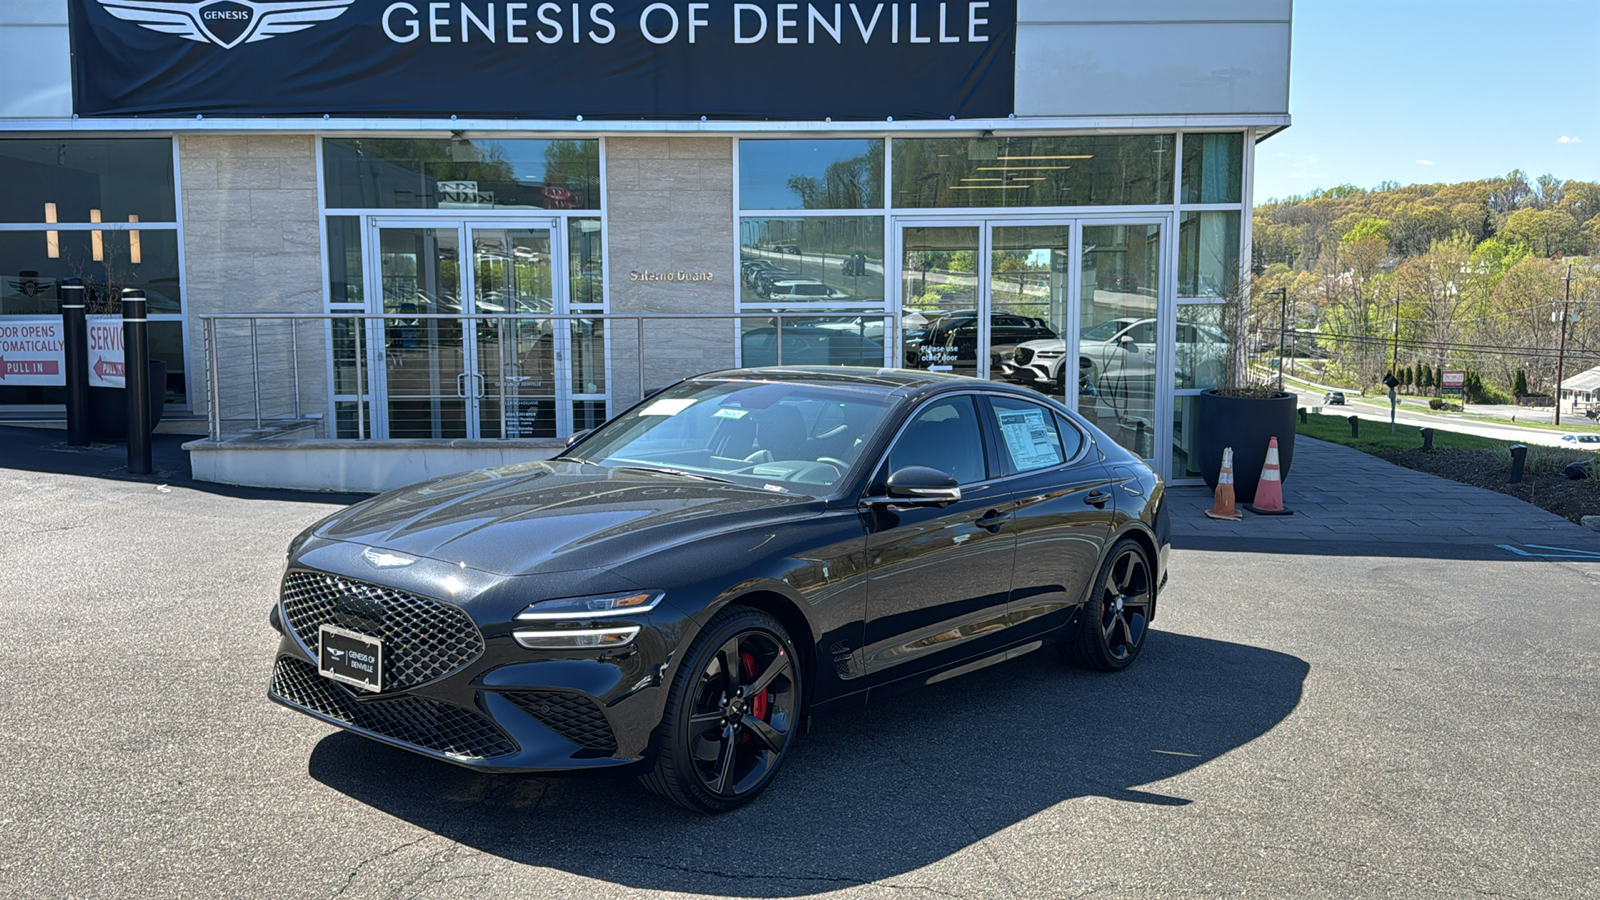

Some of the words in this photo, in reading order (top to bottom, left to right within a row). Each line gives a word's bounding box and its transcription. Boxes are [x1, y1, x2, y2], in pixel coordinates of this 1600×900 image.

[203, 11, 249, 20] GENESIS
[381, 2, 616, 44] GENESIS
[639, 2, 709, 44] OF
[733, 2, 990, 44] DENVILLE
[630, 270, 673, 281] Salerno
[677, 270, 714, 281] Duane
[21, 326, 55, 338] OPENS
[921, 353, 941, 361] other
[942, 353, 958, 361] door
[7, 362, 29, 373] PULL
[33, 362, 43, 373] IN
[348, 651, 368, 662] GENESIS
[351, 660, 373, 673] DENVILLE
